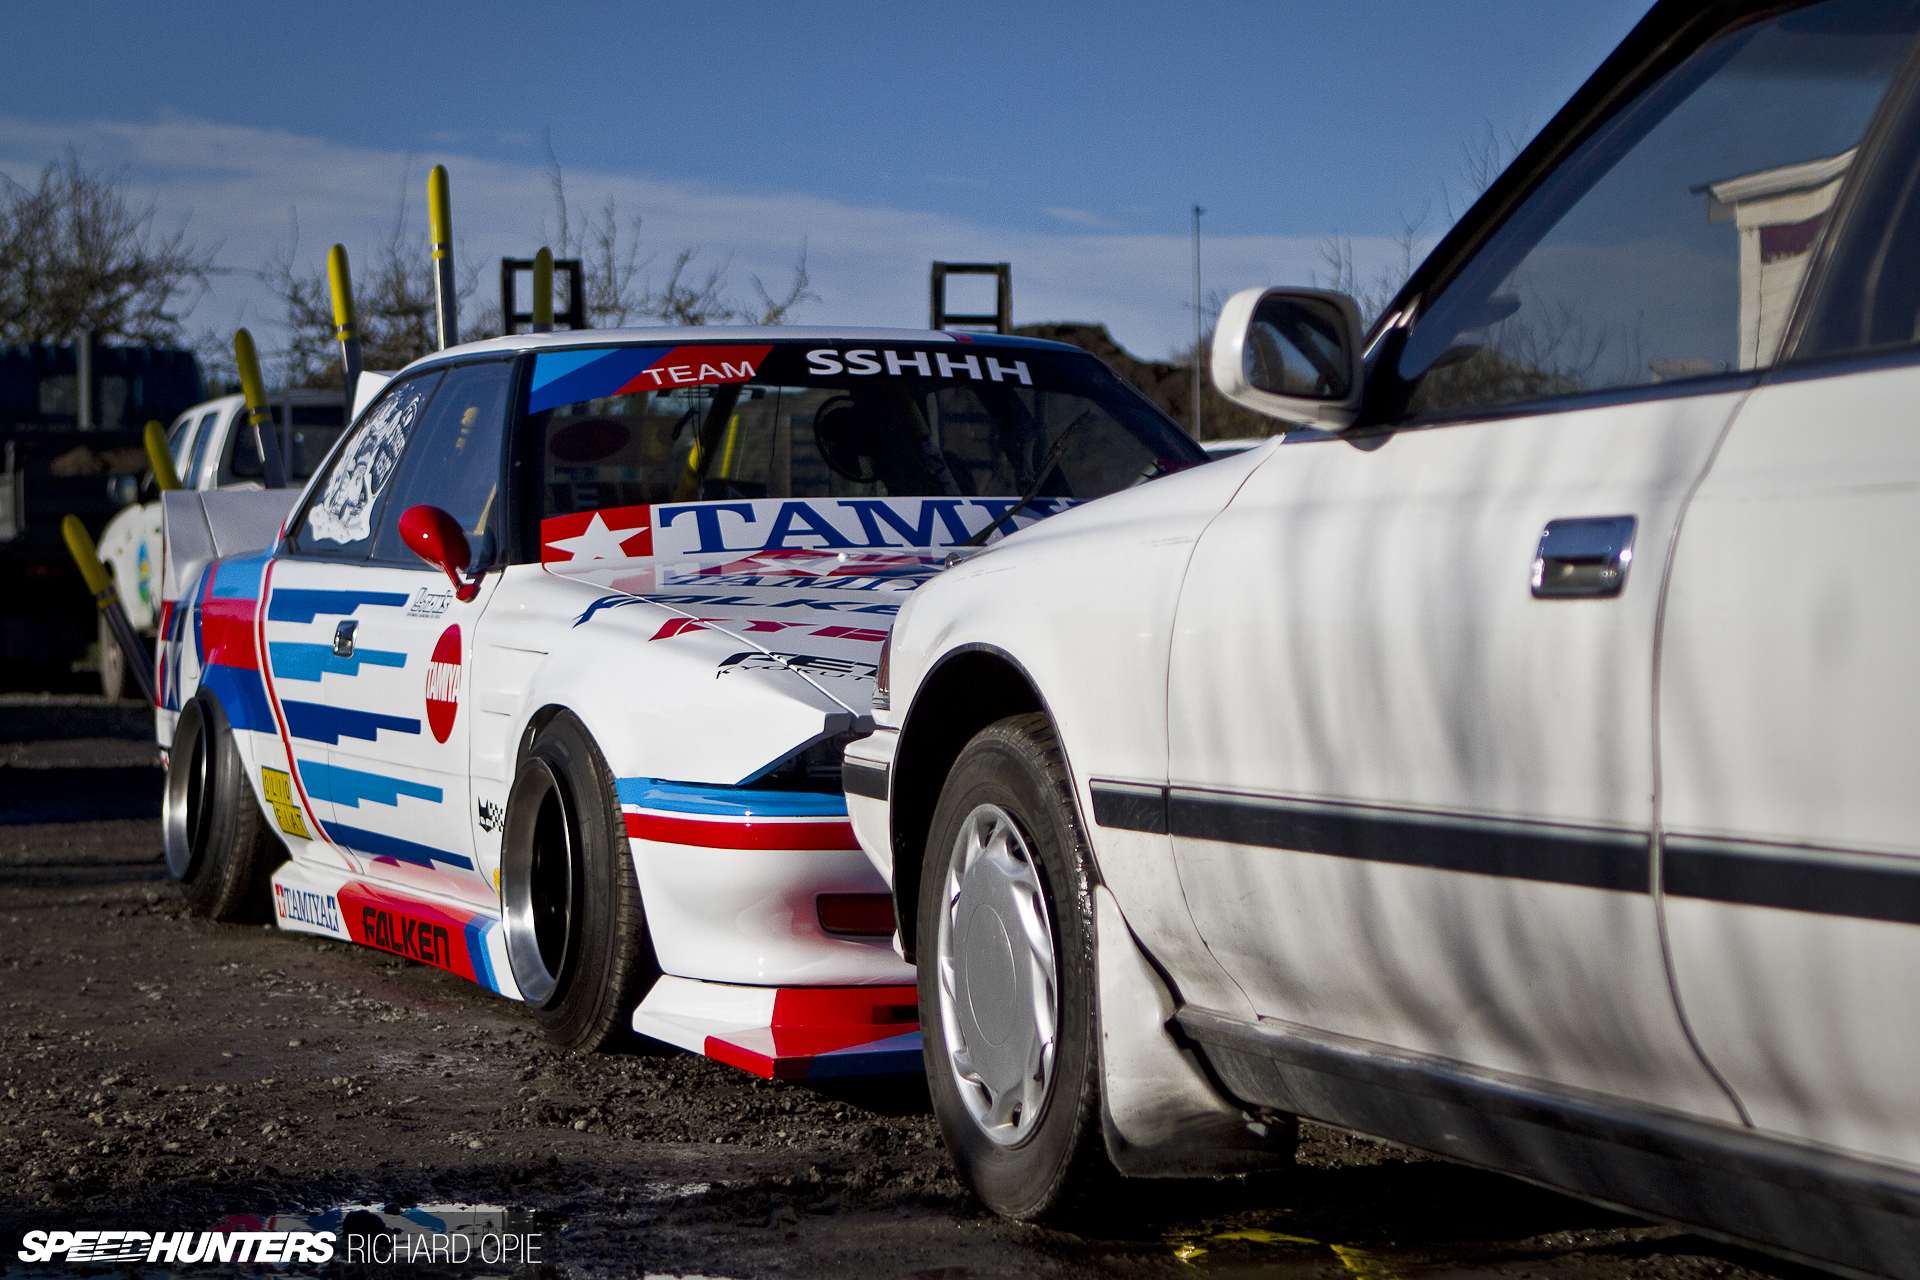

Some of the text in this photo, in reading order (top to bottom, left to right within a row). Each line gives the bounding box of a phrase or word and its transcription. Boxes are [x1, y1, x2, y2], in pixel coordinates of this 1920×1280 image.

[643, 349, 1034, 387] TEAM SSHHH
[425, 661, 462, 704] TAMIYA
[264, 774, 291, 801] OLIO
[276, 807, 307, 834] FIAT
[284, 886, 329, 927] TAMIYA
[361, 905, 451, 969] FALKEN
